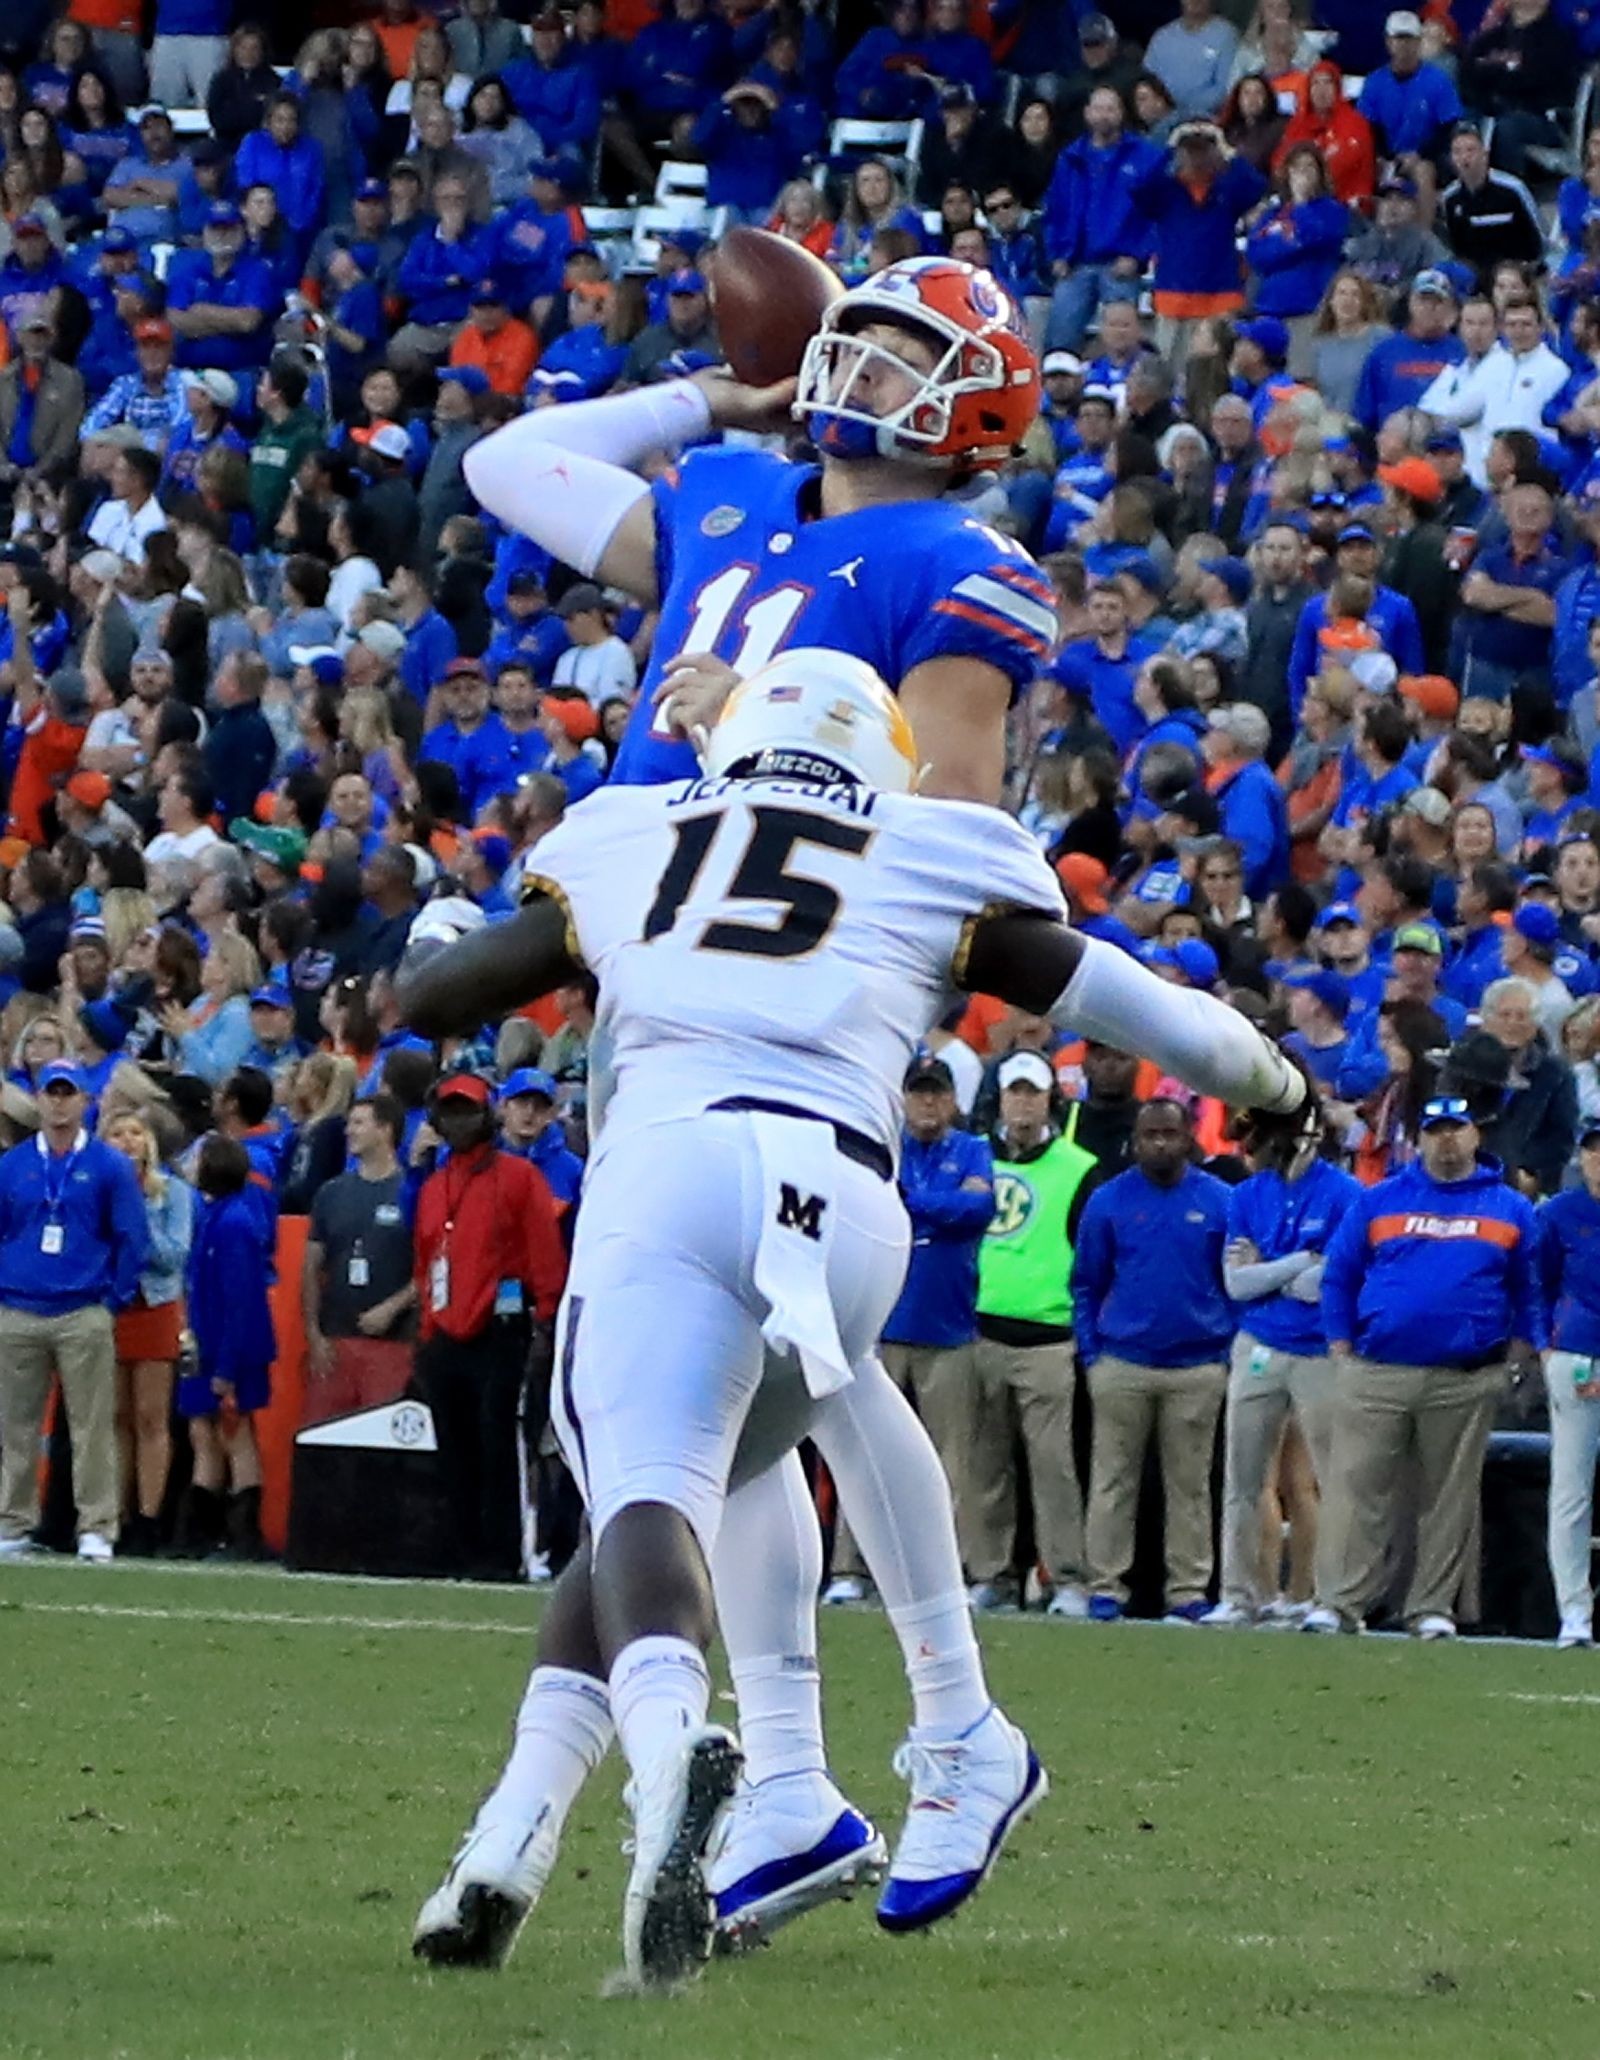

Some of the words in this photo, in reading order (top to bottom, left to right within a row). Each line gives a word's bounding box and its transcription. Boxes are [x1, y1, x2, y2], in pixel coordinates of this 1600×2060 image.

[649, 560, 817, 741] 11
[642, 804, 880, 961] 15
[777, 1182, 827, 1241] M
